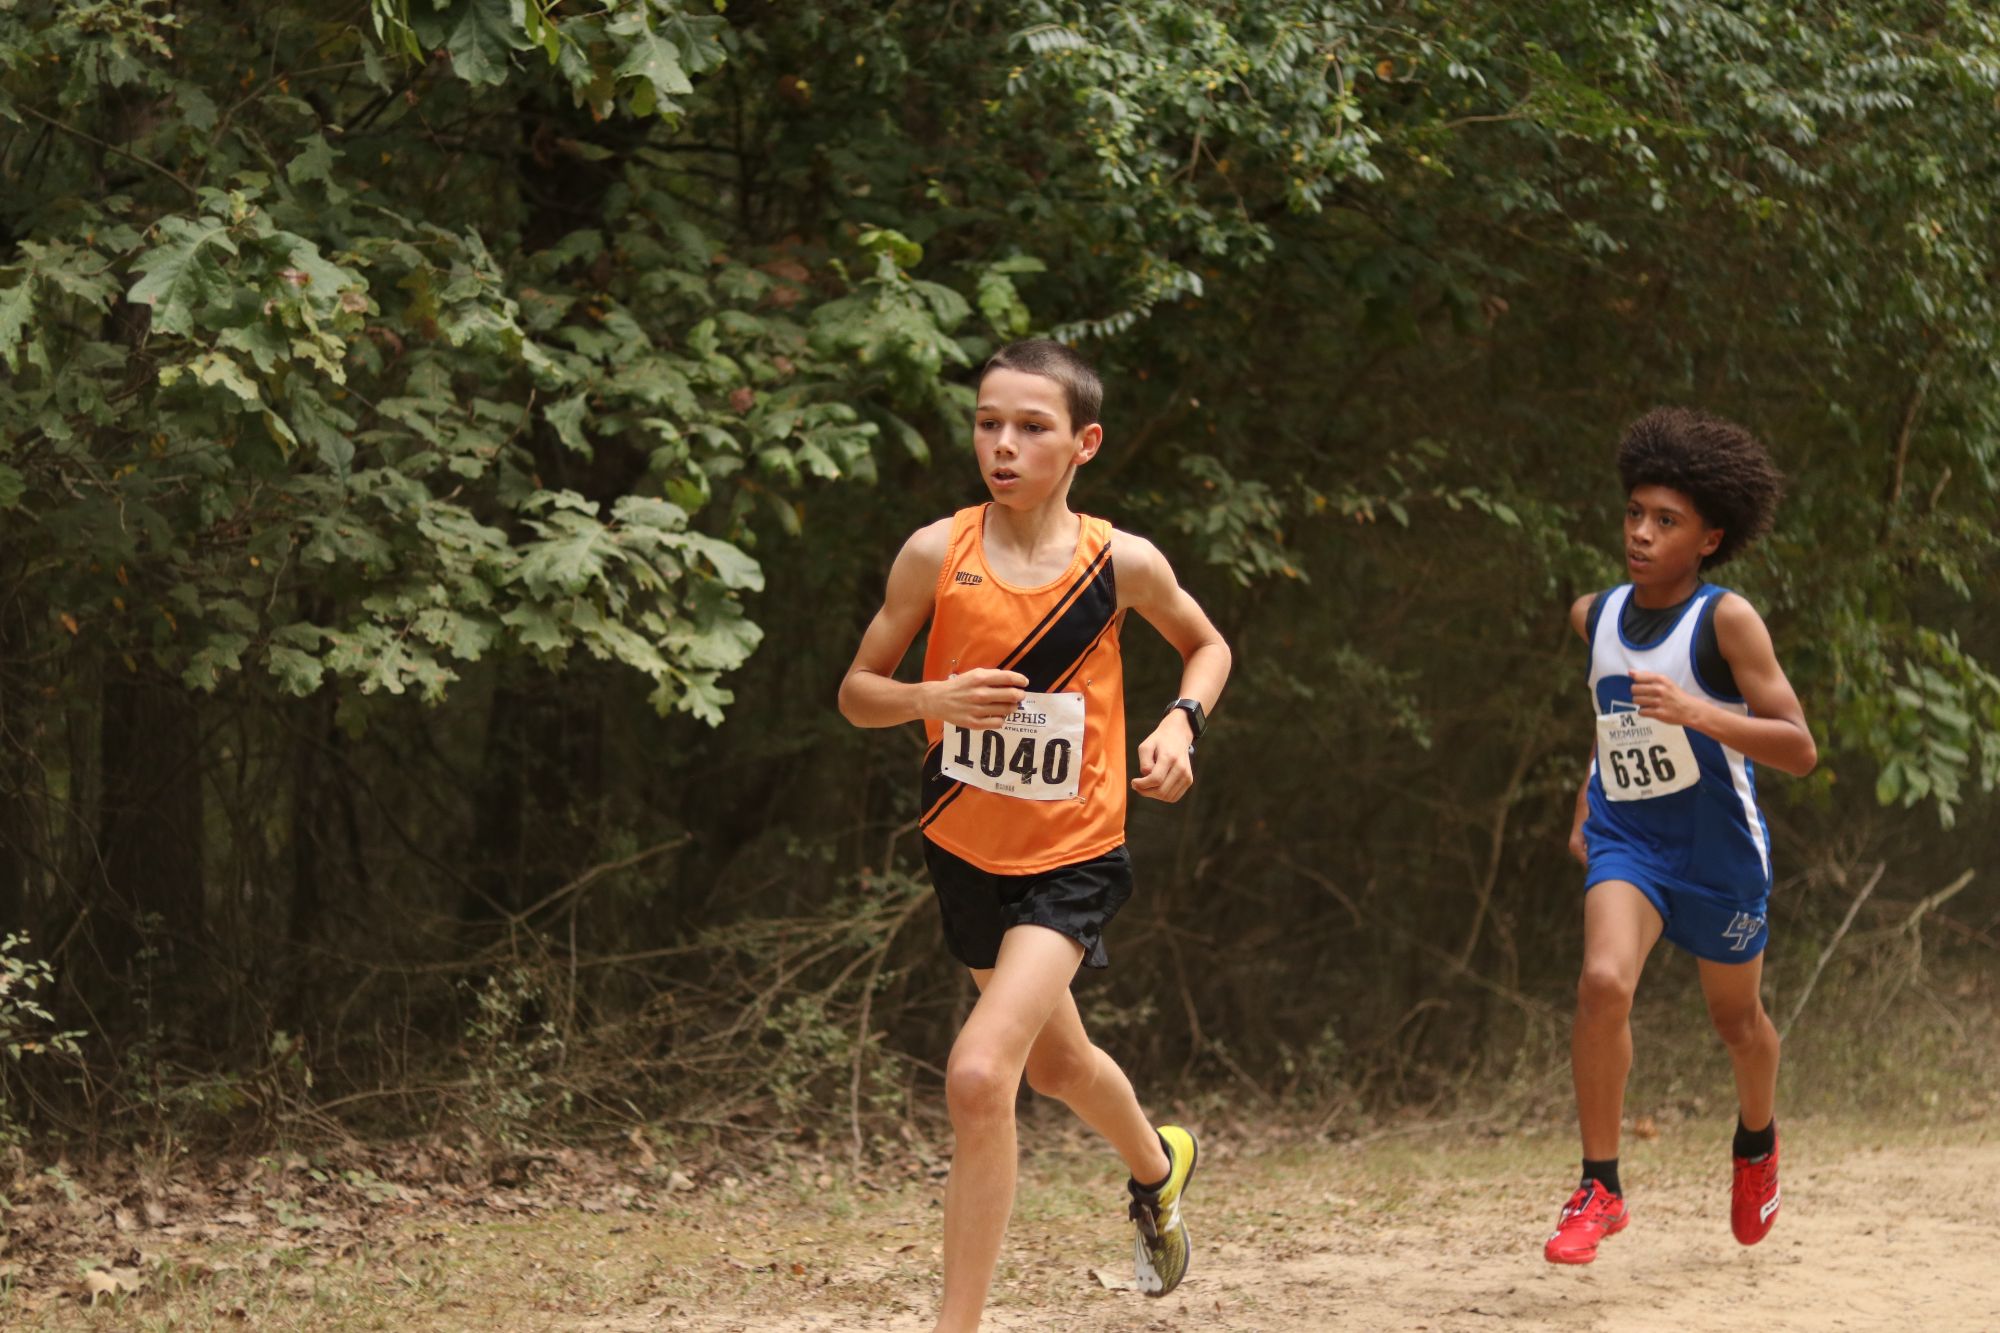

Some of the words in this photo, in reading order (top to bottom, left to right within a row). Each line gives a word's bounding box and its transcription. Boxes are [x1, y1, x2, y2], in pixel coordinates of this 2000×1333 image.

[954, 725, 1072, 785] 1040
[1609, 726, 1653, 740] MEMPHIS
[1609, 744, 1676, 789] 636
